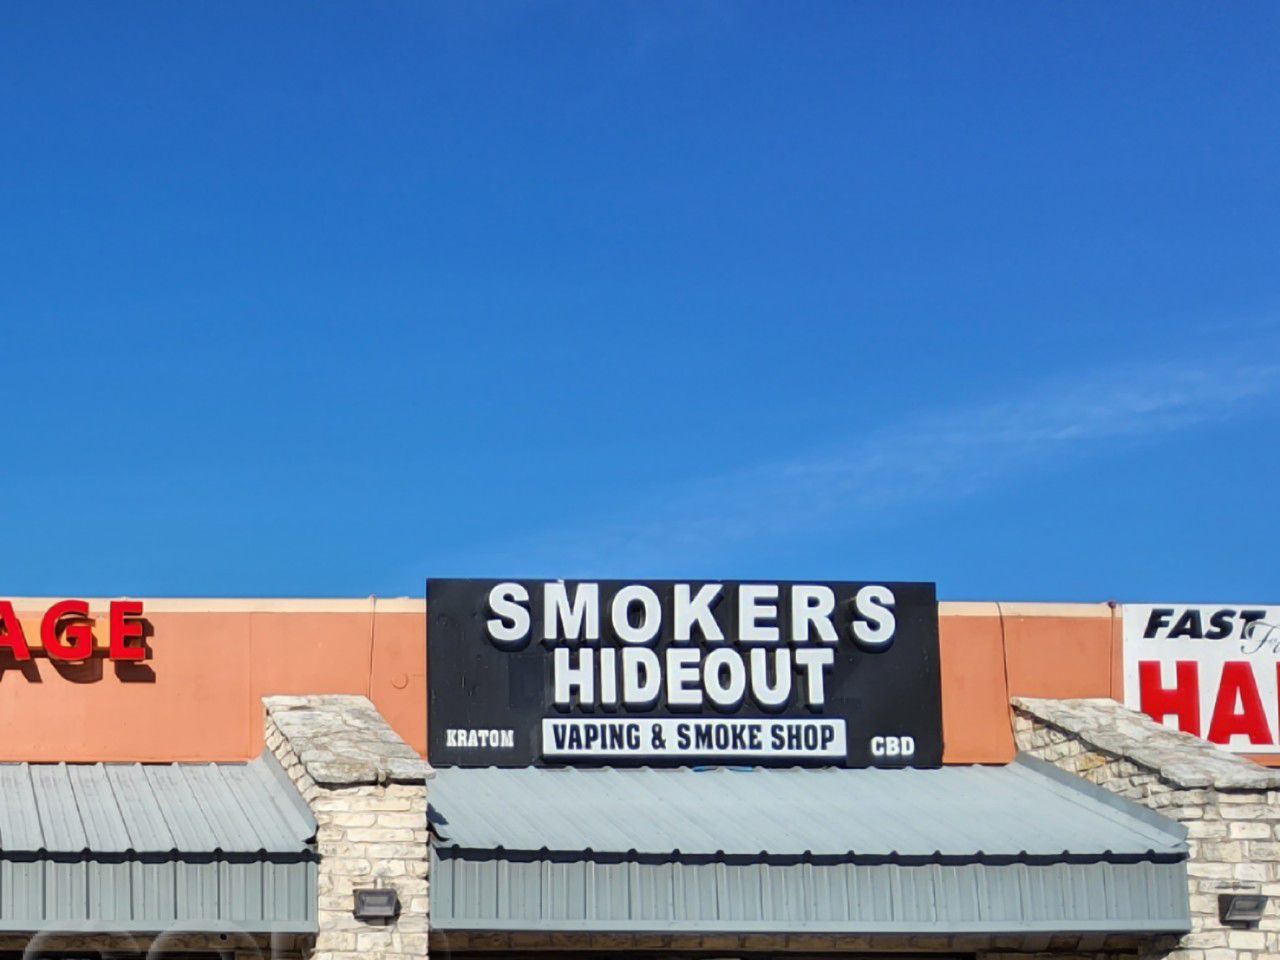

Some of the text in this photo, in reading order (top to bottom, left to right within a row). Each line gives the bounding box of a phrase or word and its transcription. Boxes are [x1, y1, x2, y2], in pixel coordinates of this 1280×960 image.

[486, 583, 896, 645] SMOKERS
[1143, 608, 1266, 640] FAST
[554, 647, 834, 706] HIDEOUT
[1138, 660, 1280, 745] HA
[446, 729, 515, 748] KRATOM
[553, 723, 835, 751] VAPING & SMOKE SHOP
[871, 736, 915, 756] CBD
